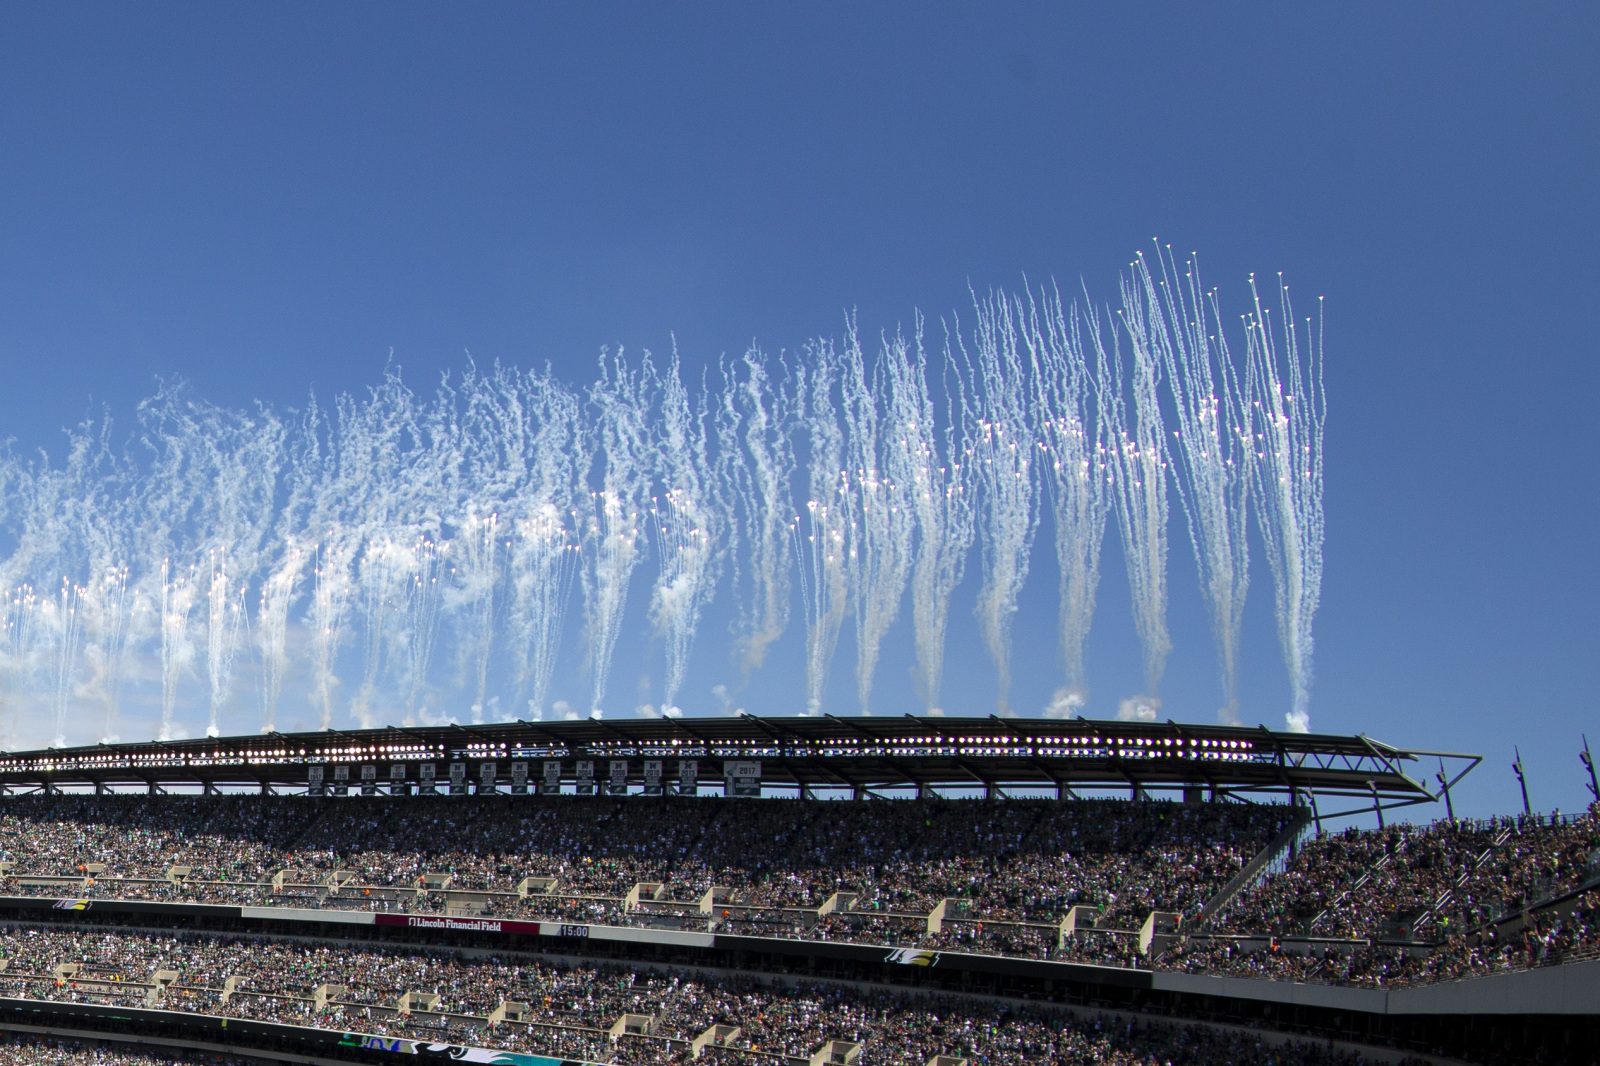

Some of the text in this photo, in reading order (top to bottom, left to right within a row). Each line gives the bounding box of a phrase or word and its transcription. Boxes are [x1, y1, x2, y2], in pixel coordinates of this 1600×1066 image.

[417, 918, 501, 932] Lincoln Financial Field
[562, 925, 588, 937] 15:00
